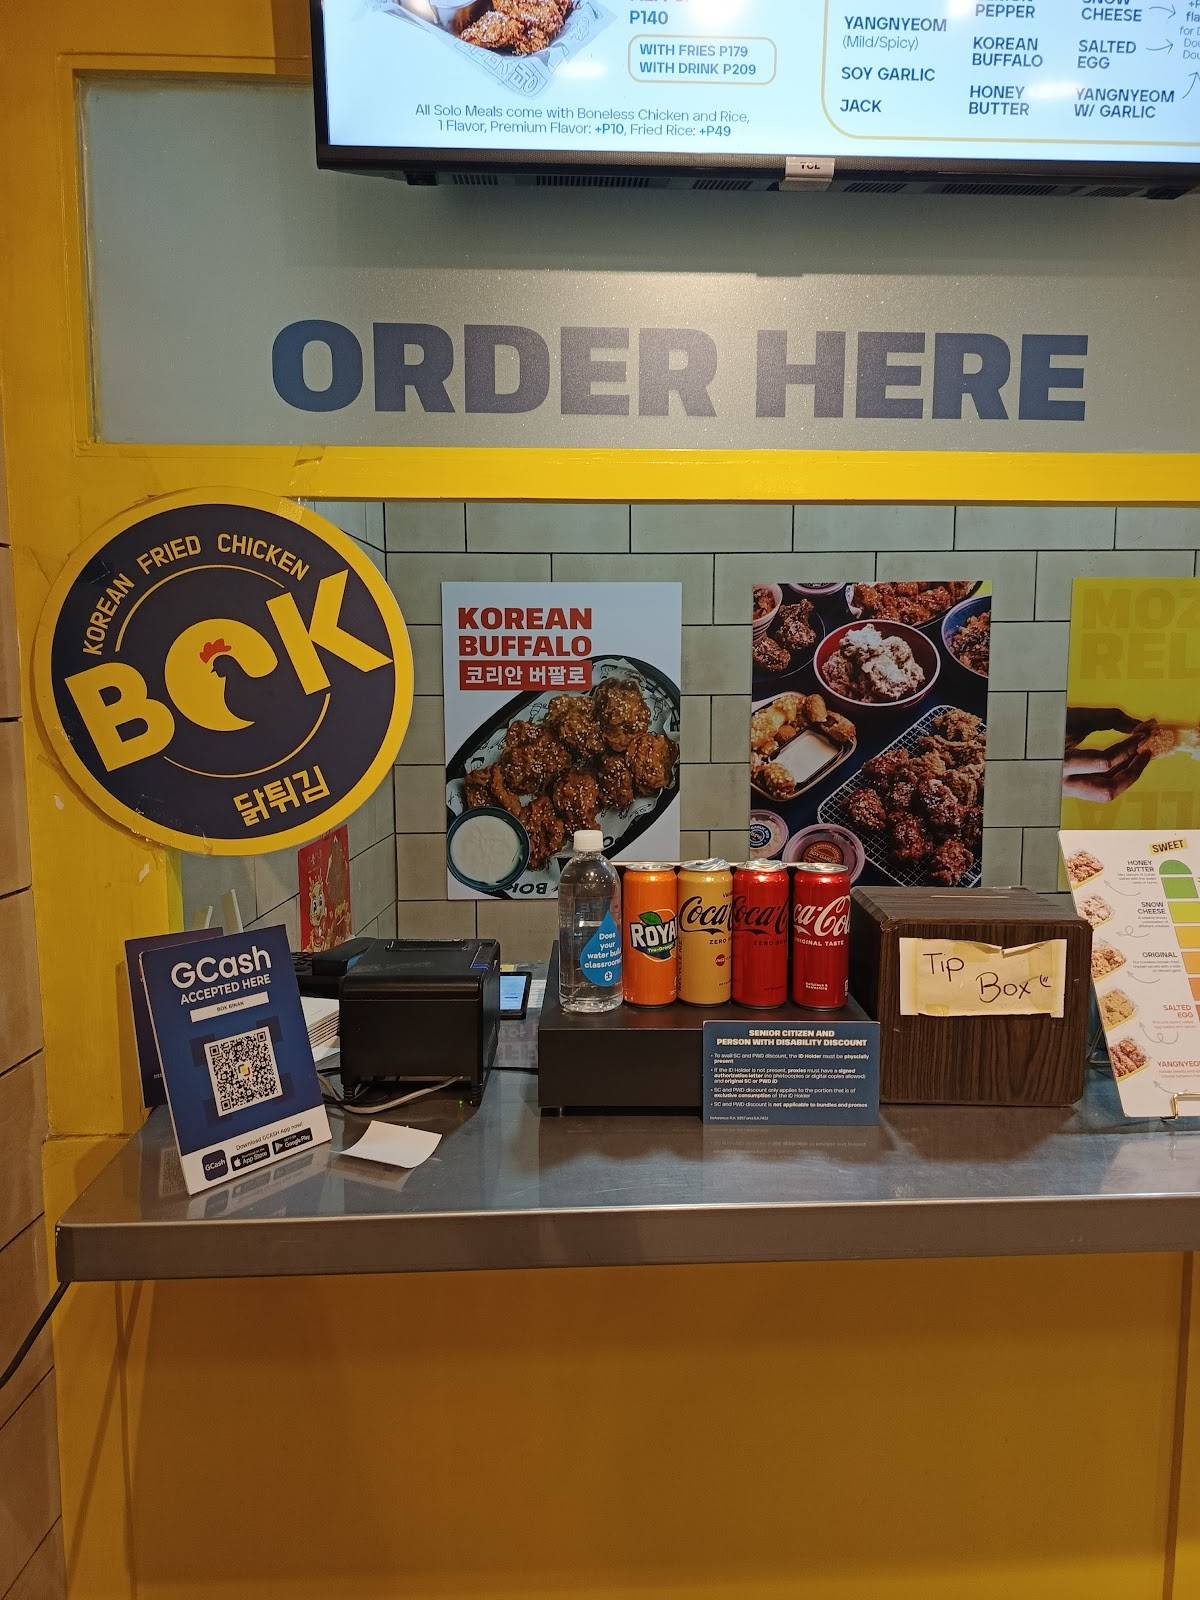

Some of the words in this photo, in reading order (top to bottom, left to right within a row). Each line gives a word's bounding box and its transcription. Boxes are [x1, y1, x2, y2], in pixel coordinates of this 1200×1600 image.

[629, 10, 668, 24] P140
[975, 4, 1036, 18] PEPPER
[1081, 8, 1142, 22] CHEESE
[844, 16, 947, 32] YANGNYEOM
[1180, 26, 1195, 36] for
[843, 35, 918, 52] (Mild/Spicy)
[973, 36, 1038, 50] KOREAN
[1079, 40, 1136, 54] SALTED
[640, 44, 674, 56] WITH
[678, 44, 716, 56] FRIES
[720, 46, 748, 58] P179
[972, 52, 1043, 68] BUFFALO
[1078, 56, 1110, 70] EGG
[640, 62, 674, 74] WITH
[678, 62, 718, 74] DRINK
[723, 64, 756, 76] P209
[841, 66, 872, 80] SOY
[878, 68, 936, 82] GARLIC
[970, 85, 1025, 99] HONEY
[1076, 88, 1175, 103] YANGNYEOM
[840, 99, 882, 112] JACK
[968, 102, 1030, 116] BUTTER
[1074, 104, 1096, 117] W/
[1100, 104, 1156, 118] GARLIC
[416, 104, 430, 116] All
[434, 104, 462, 116] Solo
[466, 105, 503, 118] Meals
[506, 108, 542, 118] come
[546, 106, 574, 119] with
[577, 108, 634, 120] Boneless
[638, 109, 689, 121] Chicken
[692, 110, 716, 122] and
[720, 110, 750, 124] Rice,
[438, 120, 443, 132] 1
[446, 120, 488, 133] Flavor,
[490, 120, 547, 133] Premium
[550, 122, 592, 134] Flavor:
[594, 124, 627, 136] +P10,
[630, 124, 663, 136] Fried
[666, 124, 696, 136] Rice:
[700, 126, 731, 137] +P49
[800, 161, 820, 170] TCL
[272, 319, 718, 418] ORDER
[756, 329, 1090, 422] HERE
[82, 573, 135, 656] KOREAN
[136, 535, 202, 577] FRIED
[216, 533, 310, 582] CHICKEN
[458, 607, 592, 630] KOREAN
[458, 636, 592, 656] BUFFALO
[466, 666, 523, 686] 코리안
[529, 666, 586, 686] 버팔로
[232, 765, 331, 827] 닭튀김
[1152, 840, 1184, 853] SWEET
[599, 932, 616, 940] Does
[600, 942, 616, 952] your
[171, 946, 272, 988] GCash
[922, 952, 964, 982] Tip
[180, 982, 240, 1005] ACCEPTED
[242, 974, 272, 990] HERE
[976, 972, 1031, 1003] Box
[716, 1038, 750, 1046] PERSON
[752, 1038, 775, 1046] WITH
[776, 1038, 822, 1046] DISABILITY
[236, 1136, 262, 1150] Download
[204, 1158, 226, 1172] GCash
[242, 1156, 254, 1165] App
